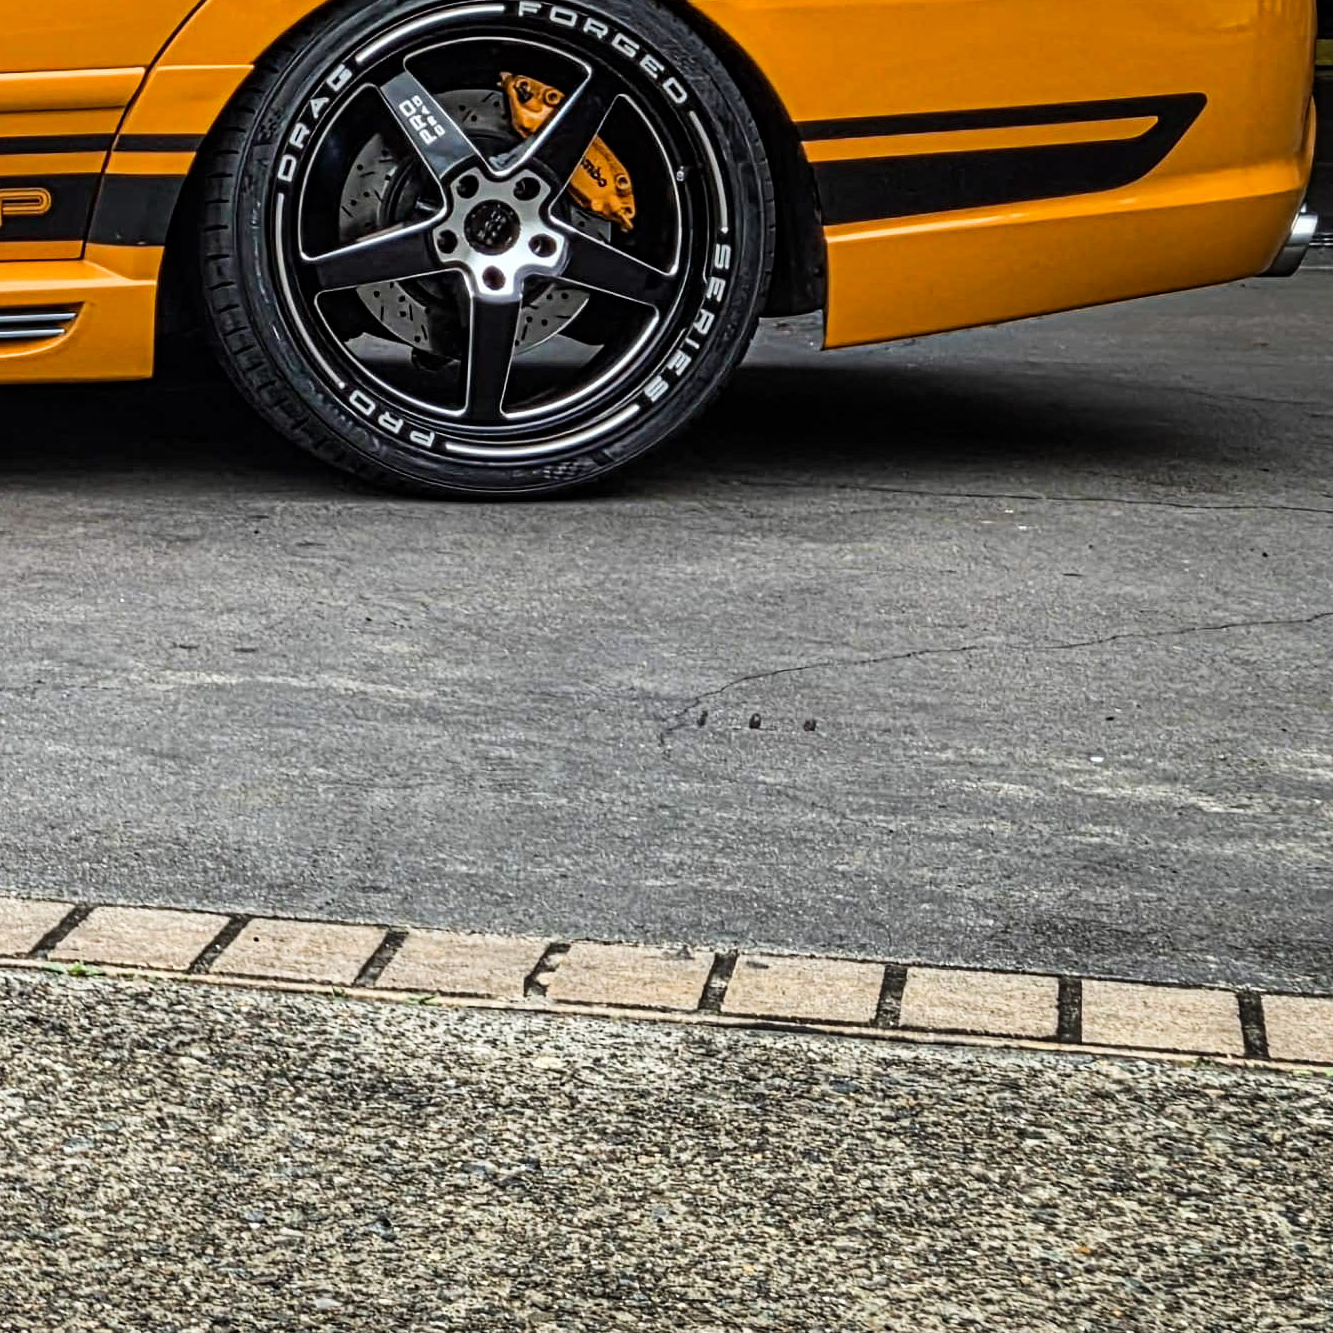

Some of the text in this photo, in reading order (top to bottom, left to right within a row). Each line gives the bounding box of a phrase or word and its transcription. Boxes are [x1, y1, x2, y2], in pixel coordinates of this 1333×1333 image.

[517, 1, 688, 105] FORGED
[278, 63, 353, 183] DRAG
[643, 240, 735, 401] SERIES
[349, 388, 435, 448] PRO
